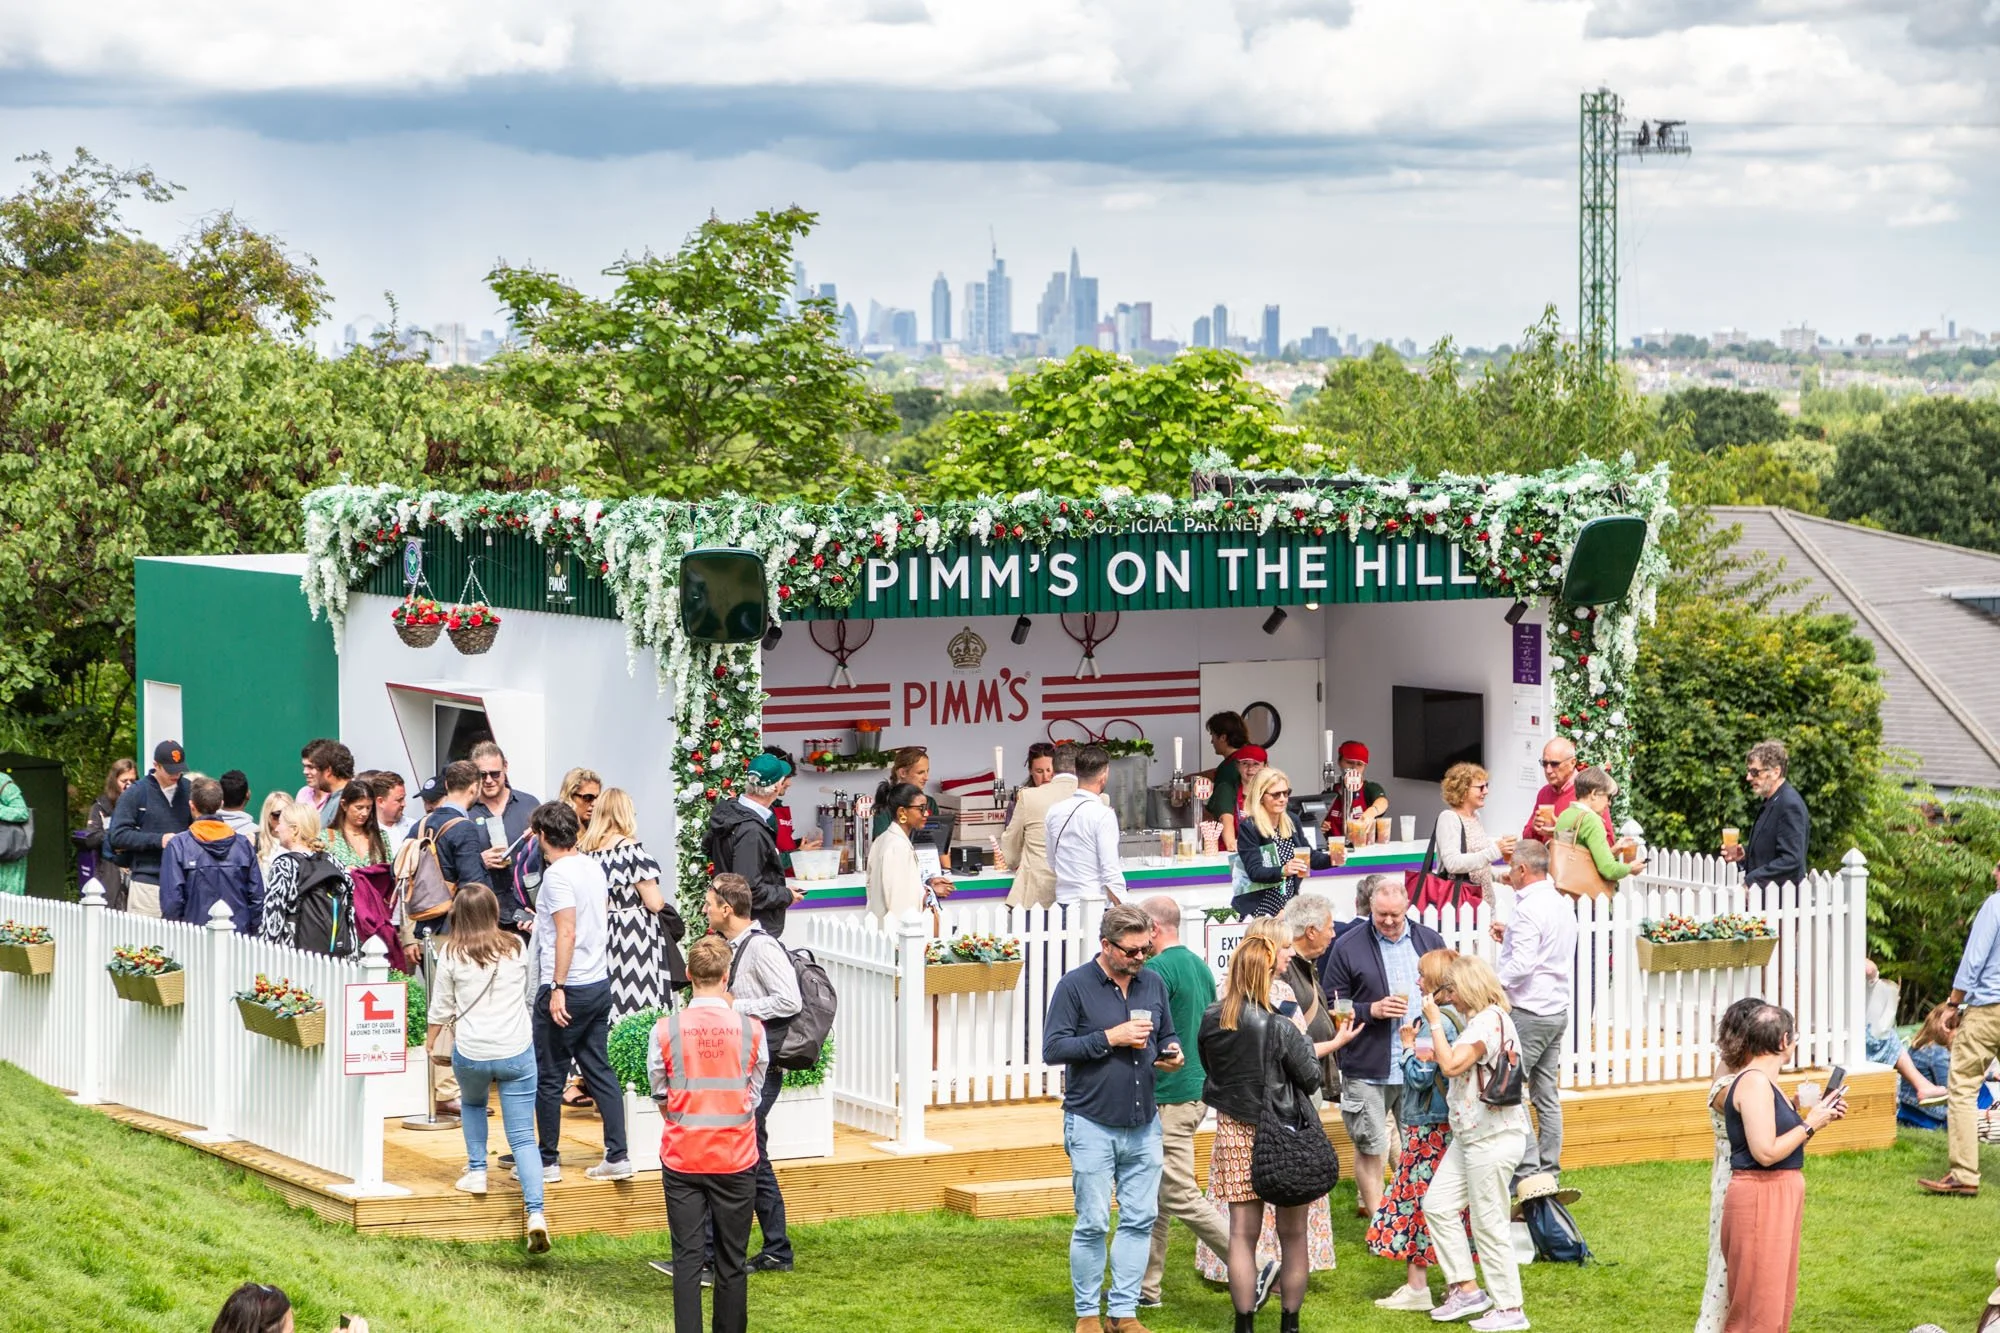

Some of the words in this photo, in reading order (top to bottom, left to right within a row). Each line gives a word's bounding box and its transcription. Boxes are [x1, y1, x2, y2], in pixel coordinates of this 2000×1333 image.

[1095, 518, 1177, 534] OFICIAL
[868, 552, 1079, 602] PIMM'S
[1106, 550, 1190, 596] ON
[1217, 546, 1328, 591] THE
[1355, 543, 1477, 587] HILL
[903, 667, 1029, 726] PIMM'S
[987, 811, 1006, 821] PIMM
[683, 1028, 708, 1037] HOW
[711, 1027, 733, 1036] CAN
[698, 1039, 724, 1049] HELP
[698, 1050, 725, 1060] YOU?
